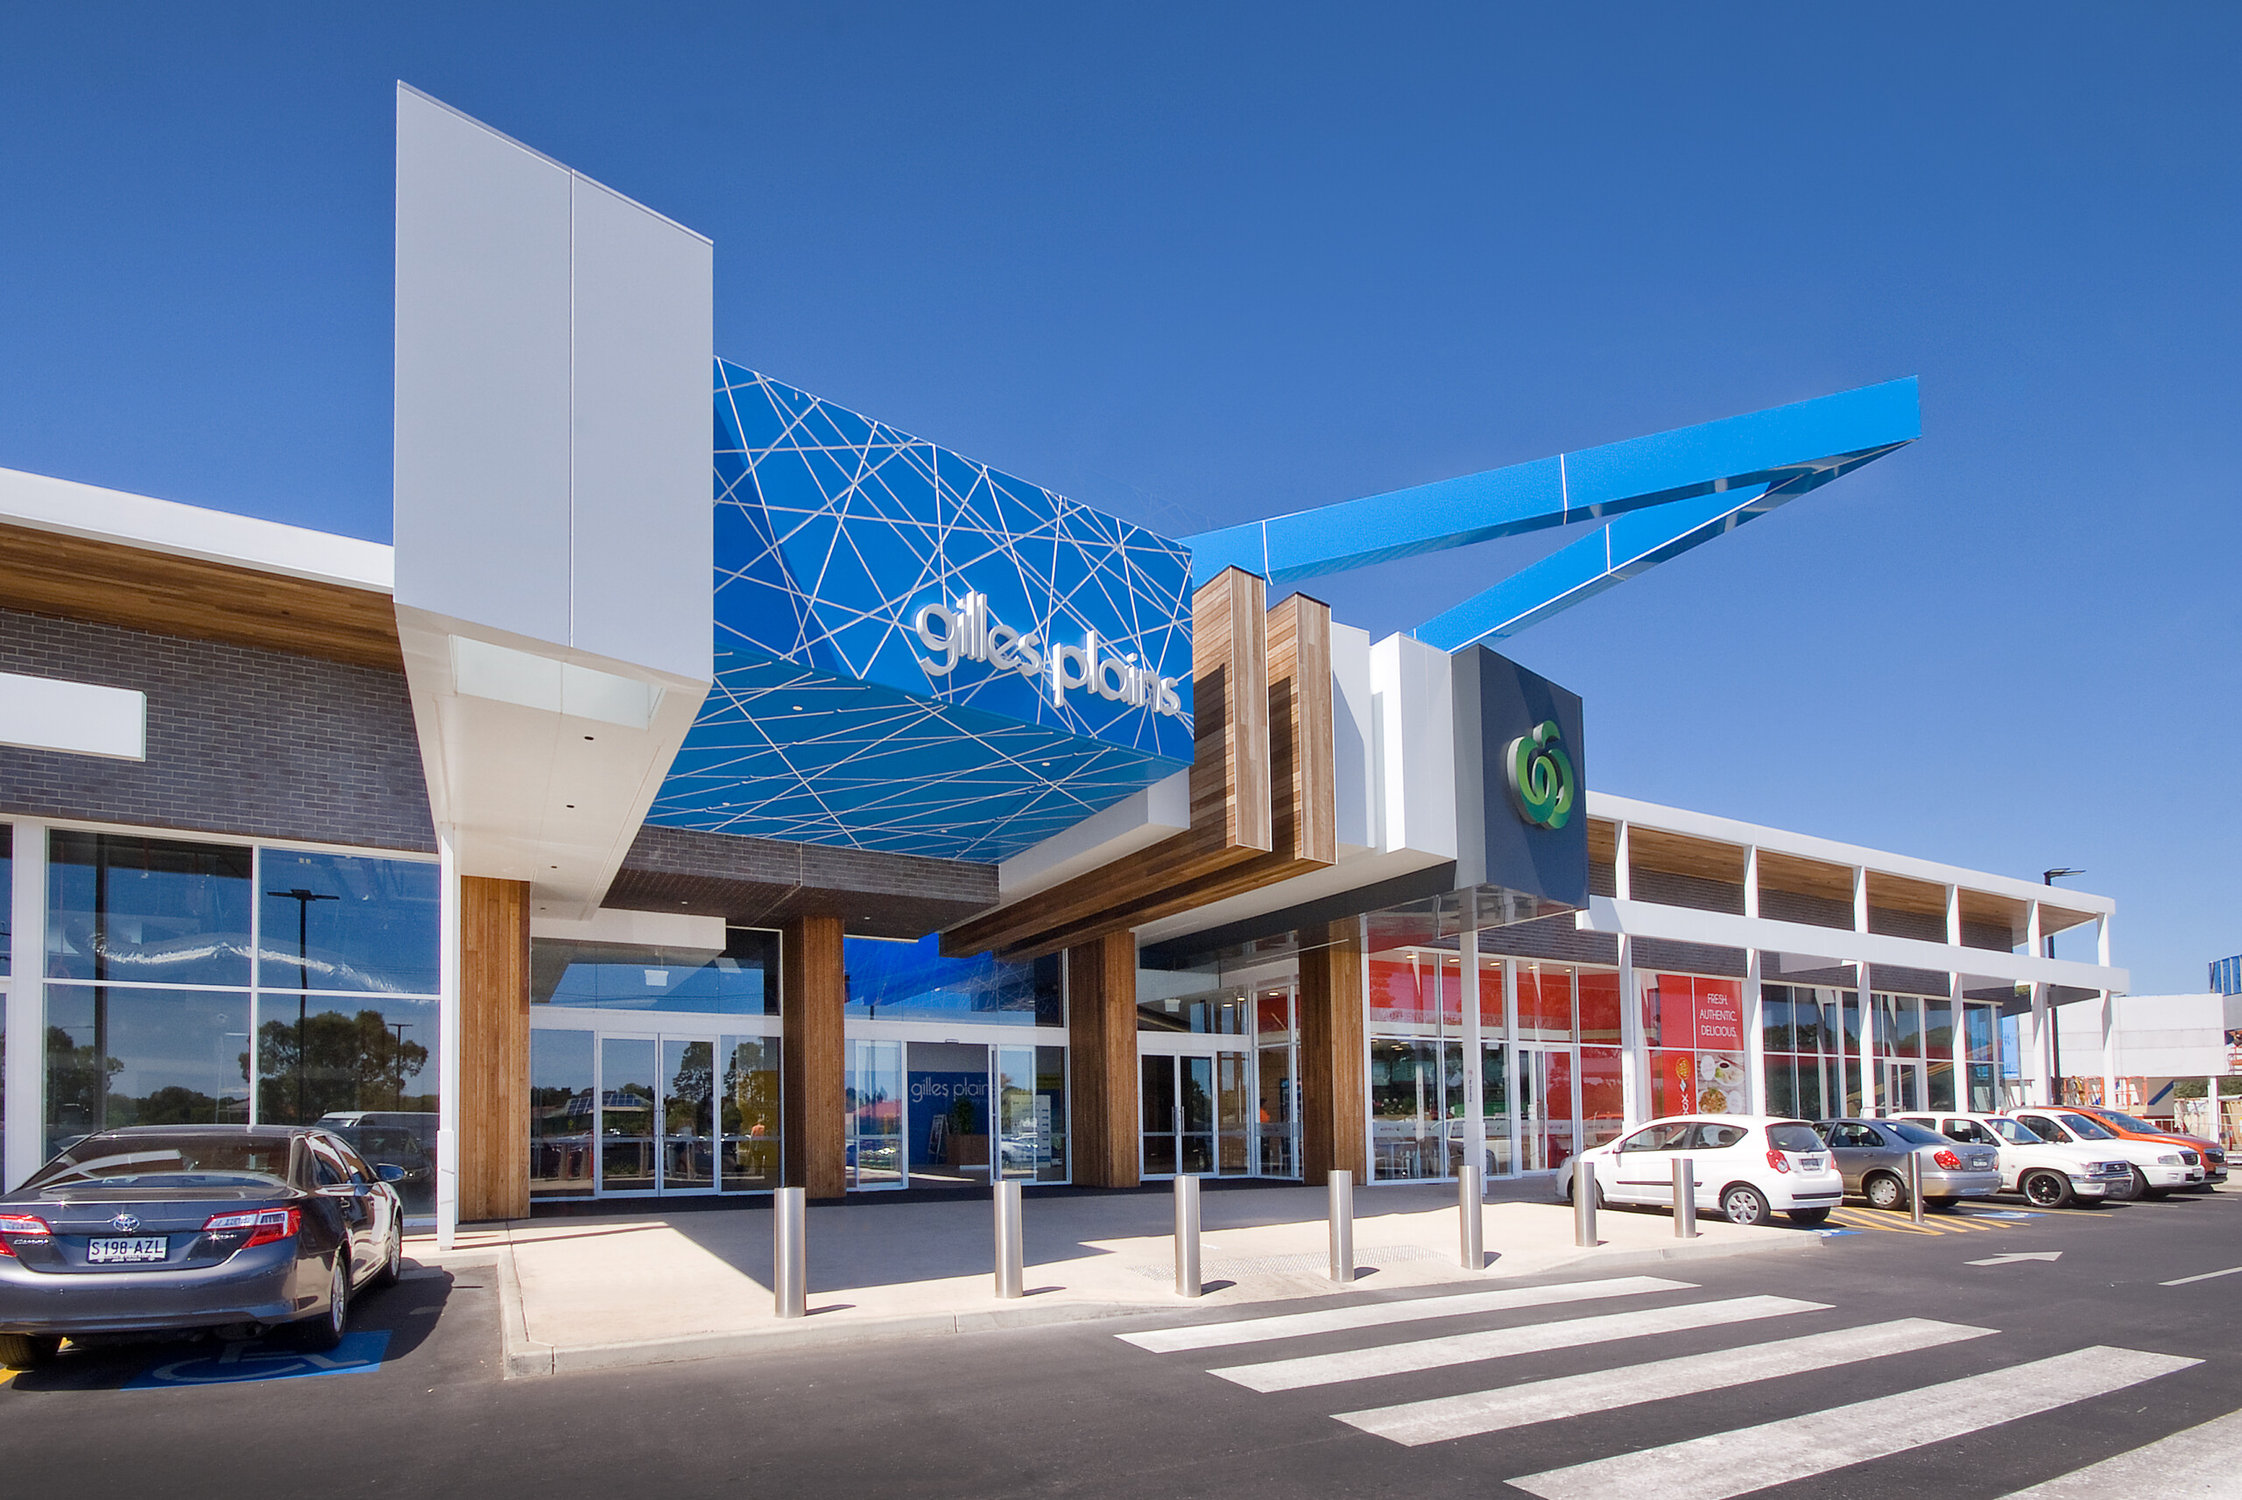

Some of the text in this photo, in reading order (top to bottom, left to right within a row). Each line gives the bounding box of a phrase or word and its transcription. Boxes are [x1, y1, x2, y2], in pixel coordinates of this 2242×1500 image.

[915, 589, 1181, 716] gilles plains
[910, 1077, 949, 1102] gilles
